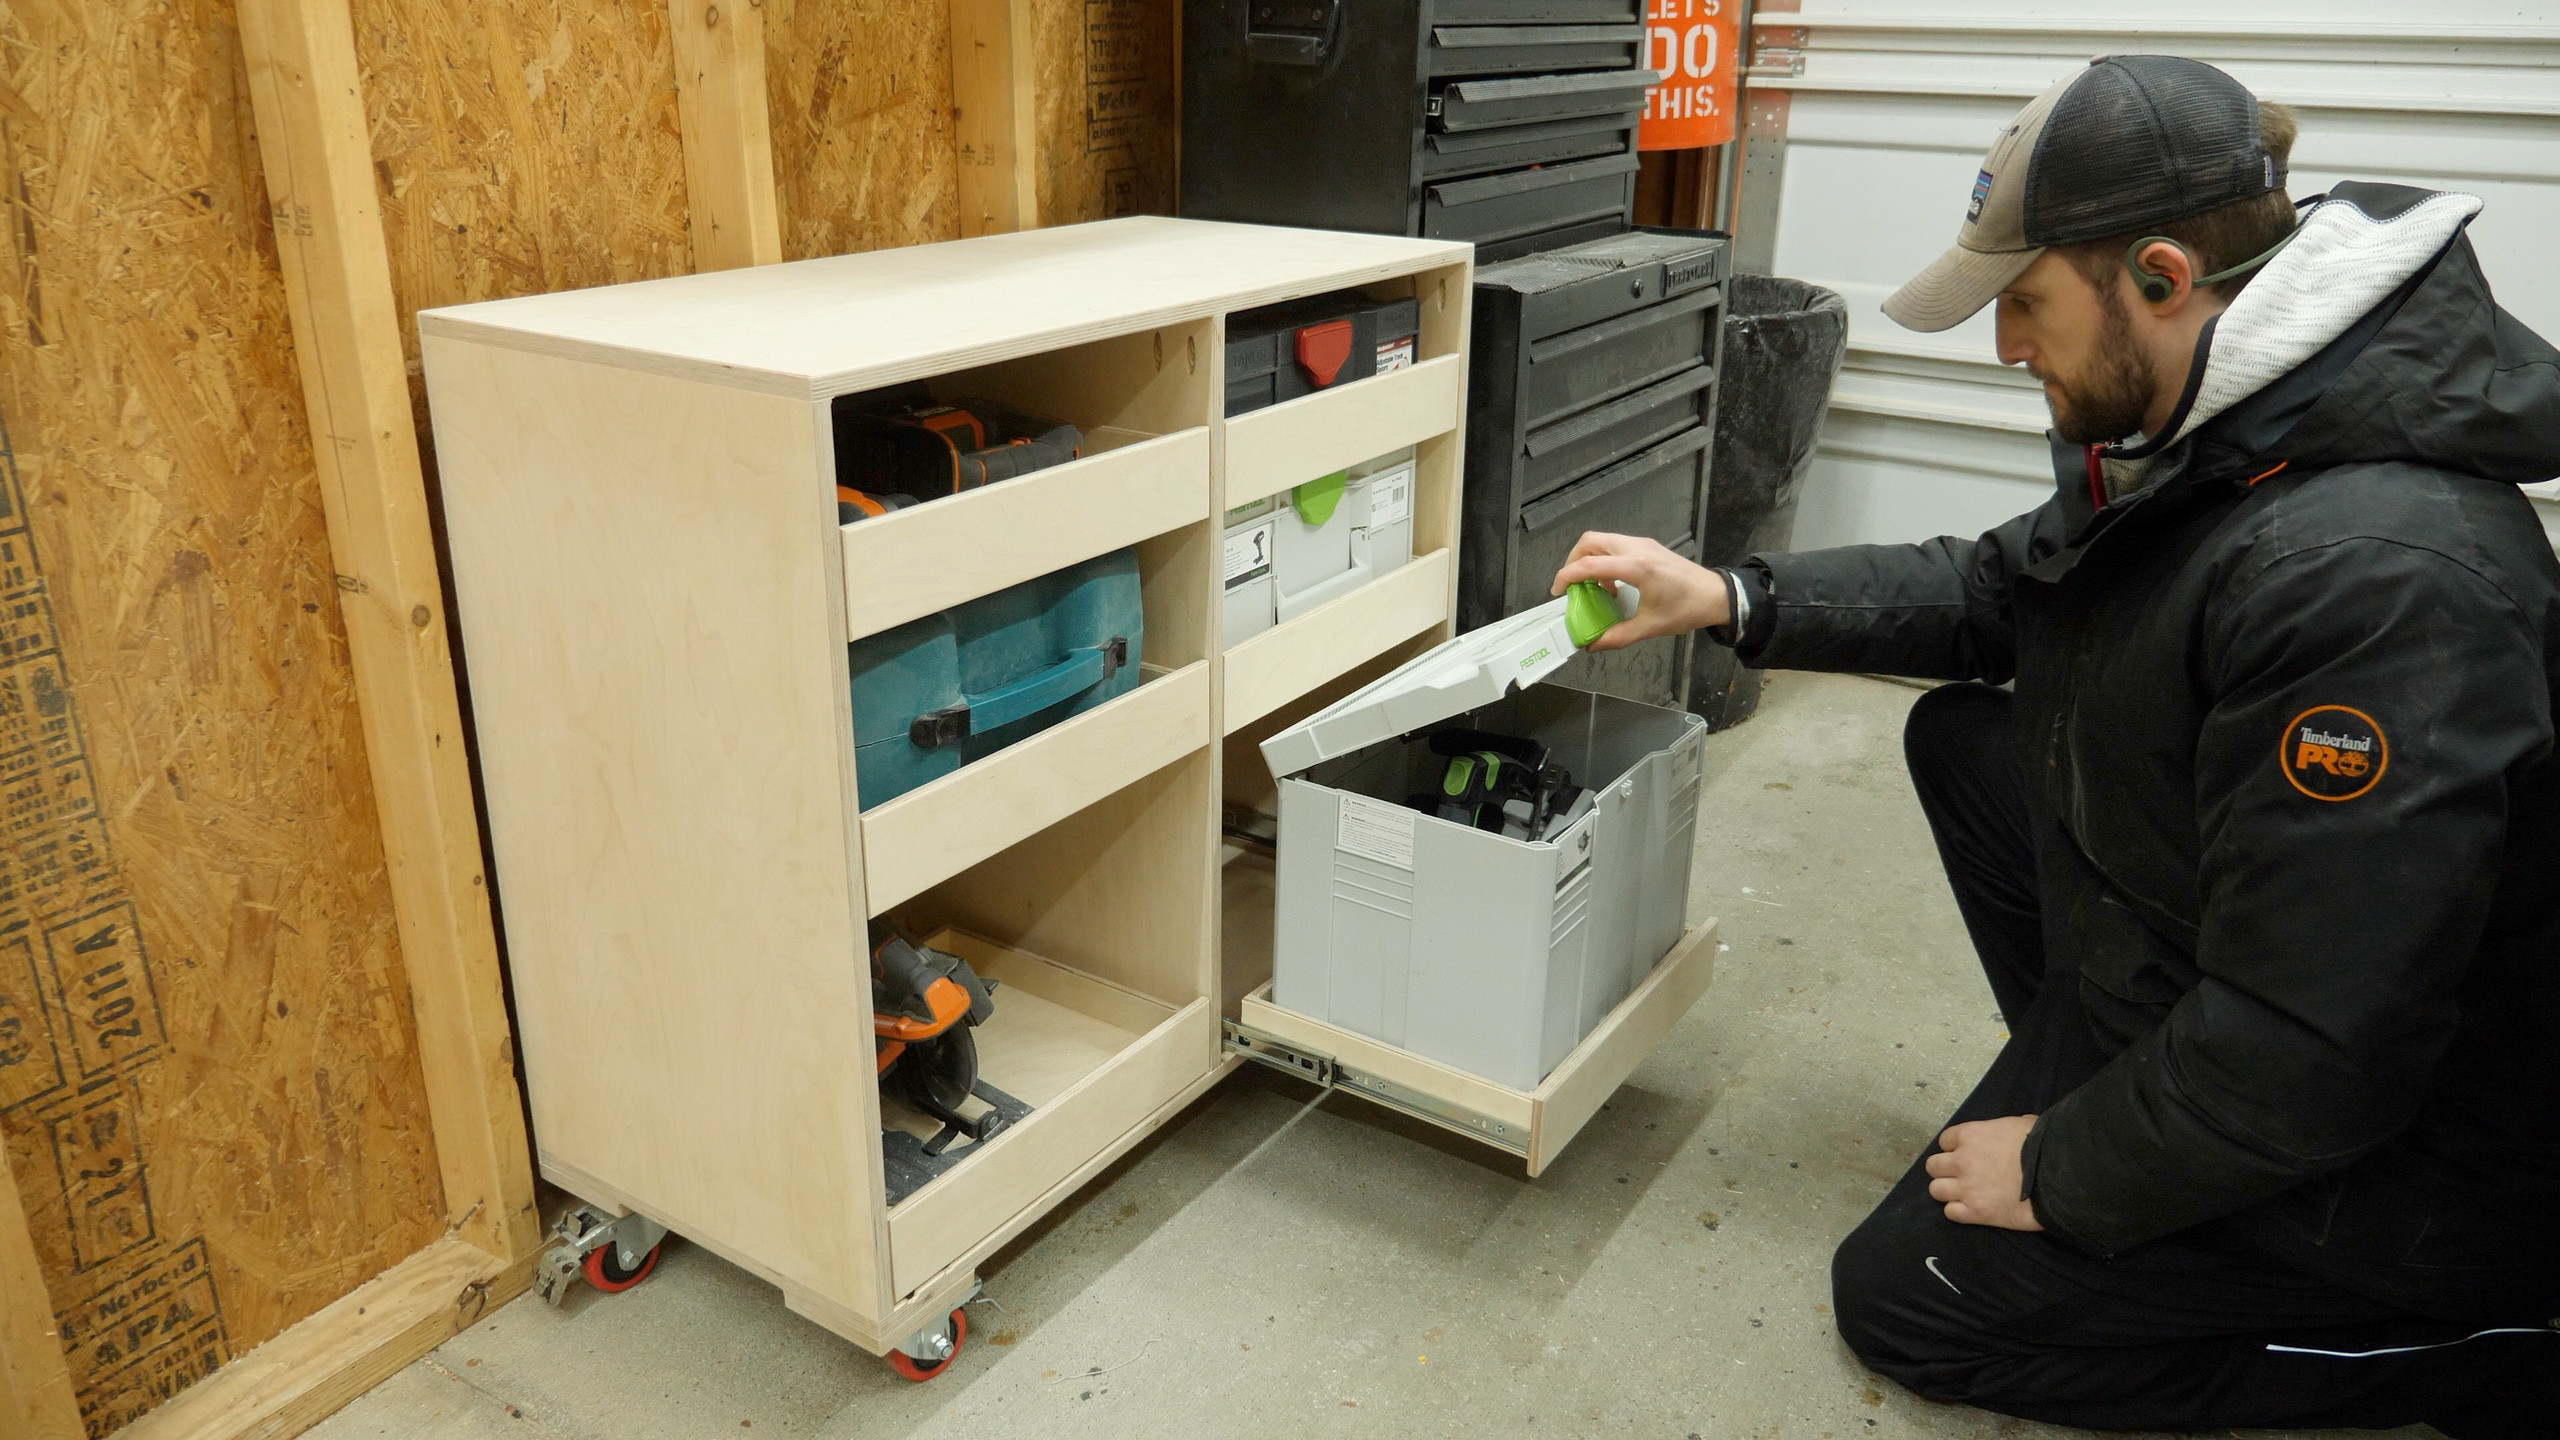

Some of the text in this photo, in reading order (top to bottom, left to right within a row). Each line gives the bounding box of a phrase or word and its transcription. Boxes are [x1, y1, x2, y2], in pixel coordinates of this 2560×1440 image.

[1643, 24, 1718, 81] DO
[1643, 85, 1720, 120] THIS.
[2300, 726, 2371, 752] Timberland
[2295, 742, 2370, 777] PRO
